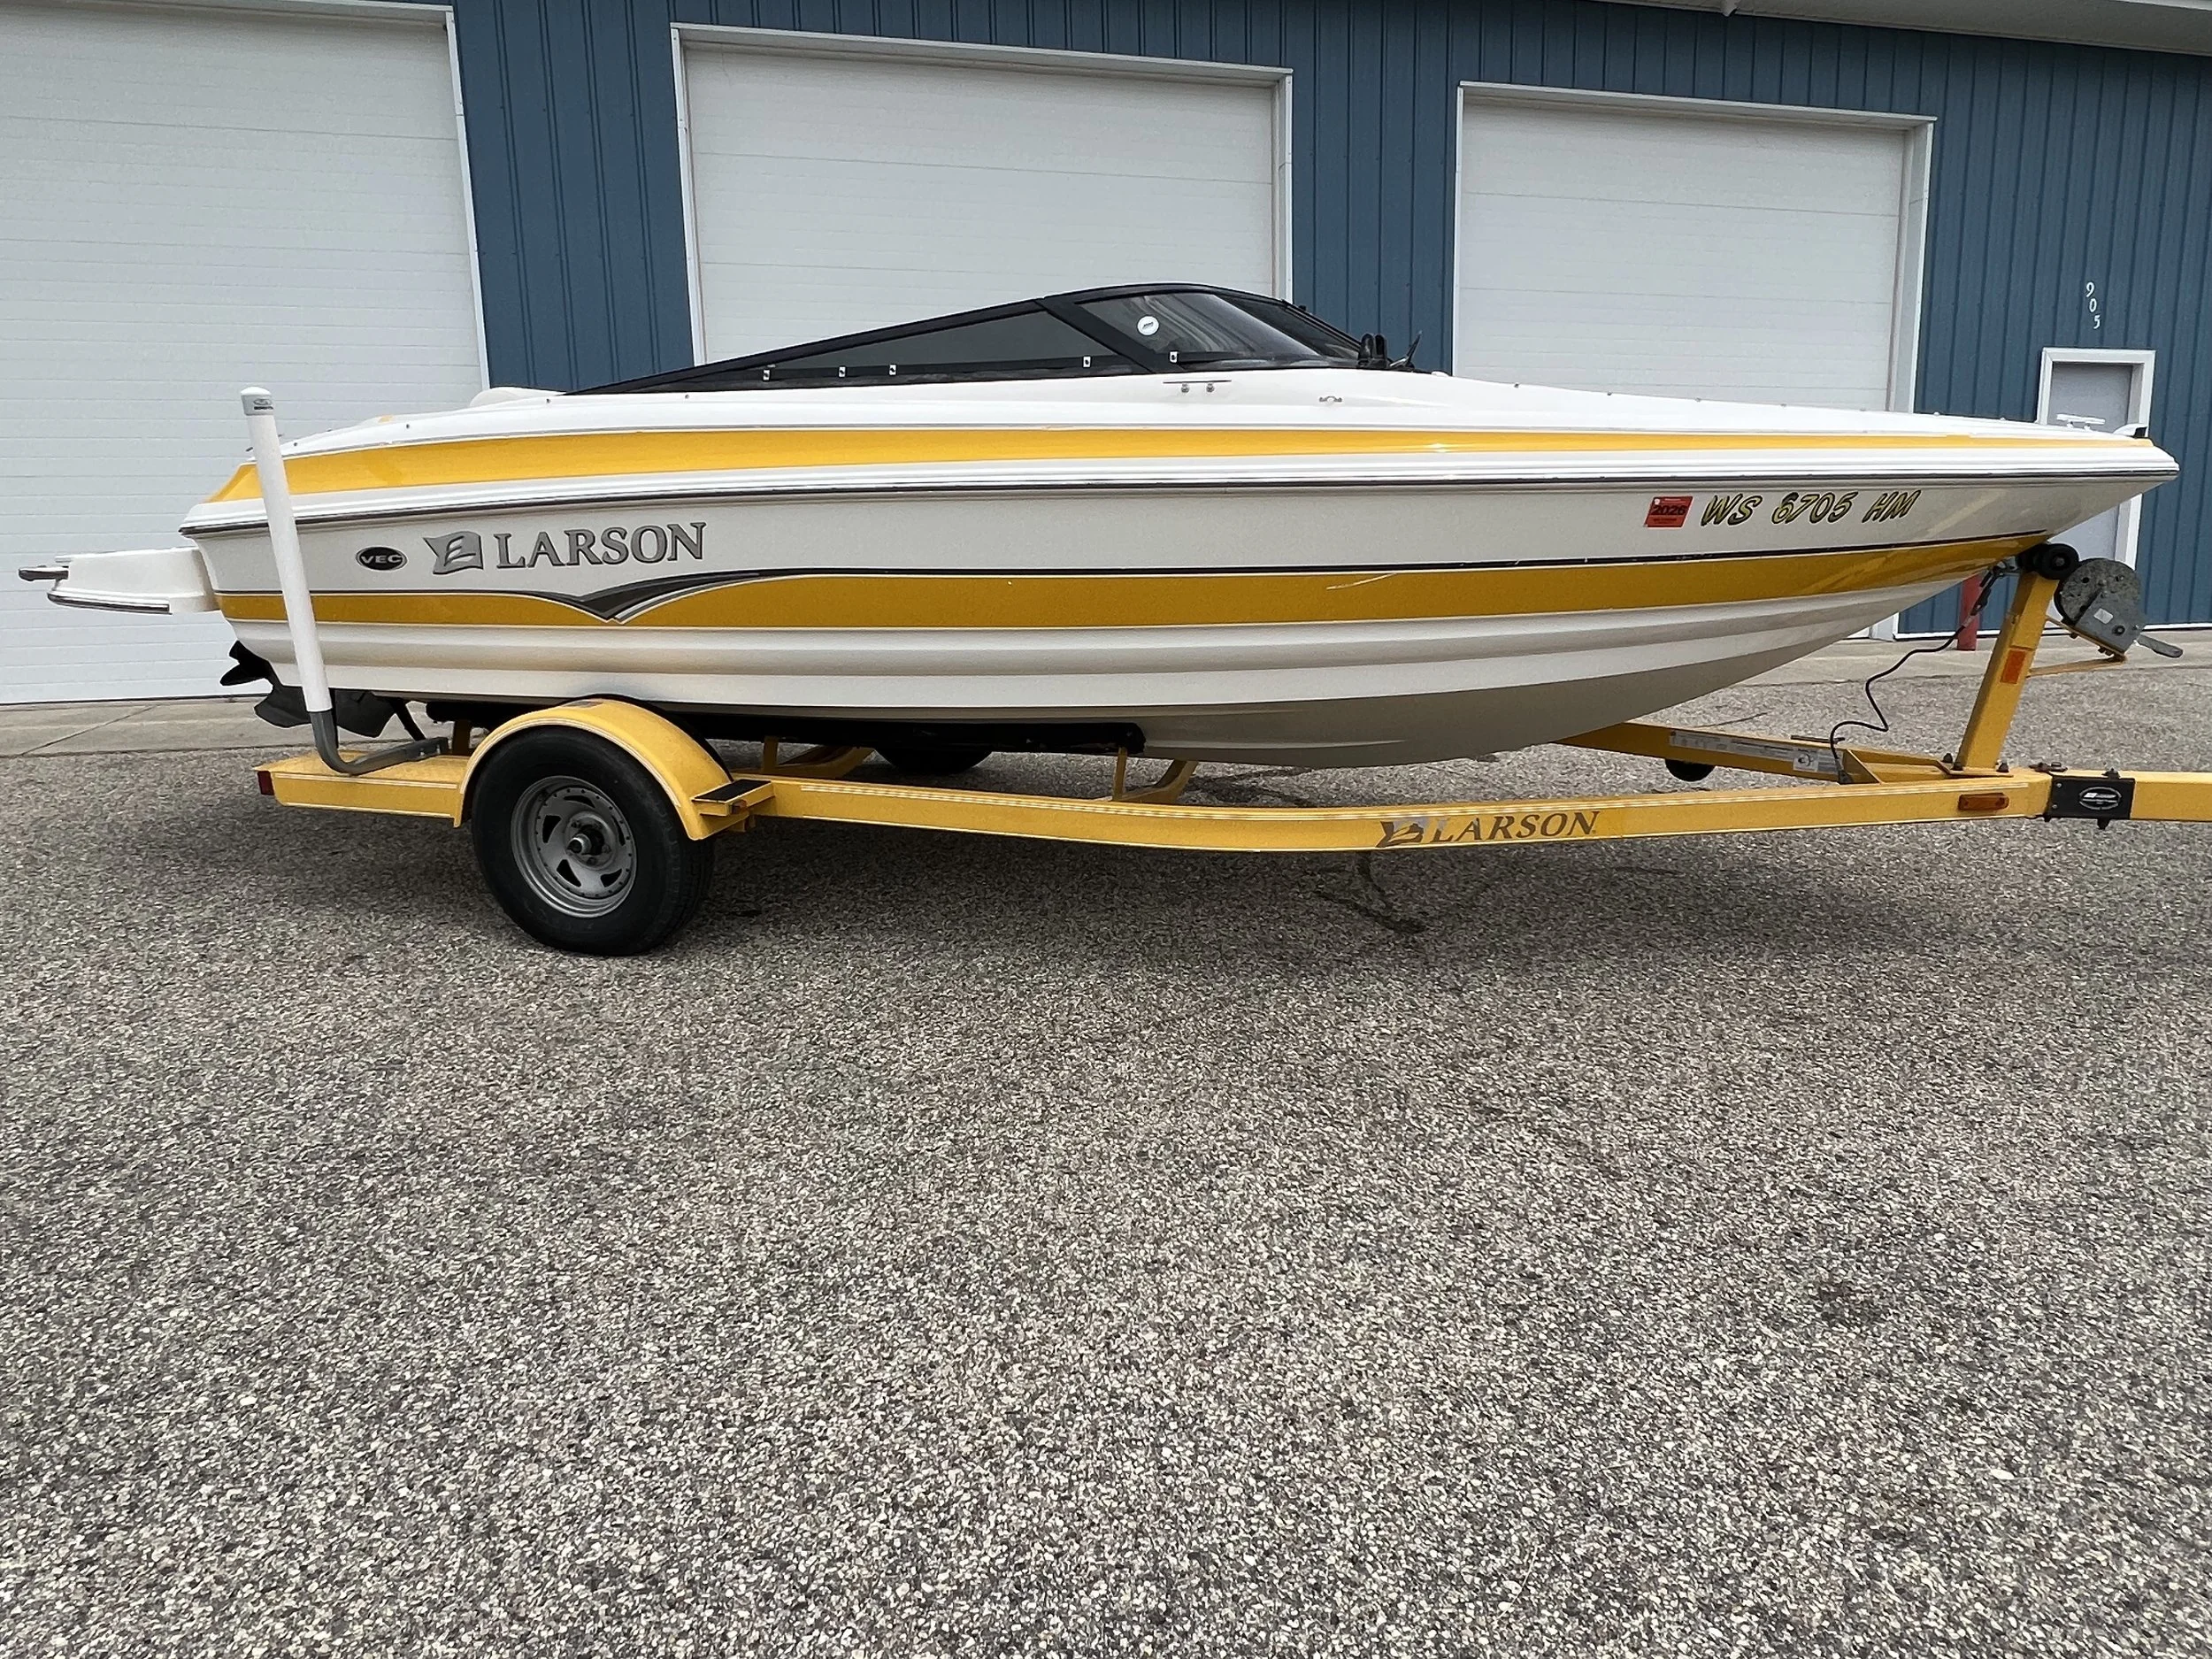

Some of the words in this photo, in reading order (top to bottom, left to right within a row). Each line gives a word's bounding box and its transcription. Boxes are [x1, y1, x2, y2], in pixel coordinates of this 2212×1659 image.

[2085, 281, 2101, 329] 905
[1650, 504, 1687, 515] 2026
[1700, 493, 1763, 526] WS
[1770, 491, 1858, 525] 6705
[1862, 490, 1922, 524] HM
[358, 554, 403, 565] VEC
[494, 521, 707, 569] LARSON
[1429, 810, 1601, 842] LARSON
